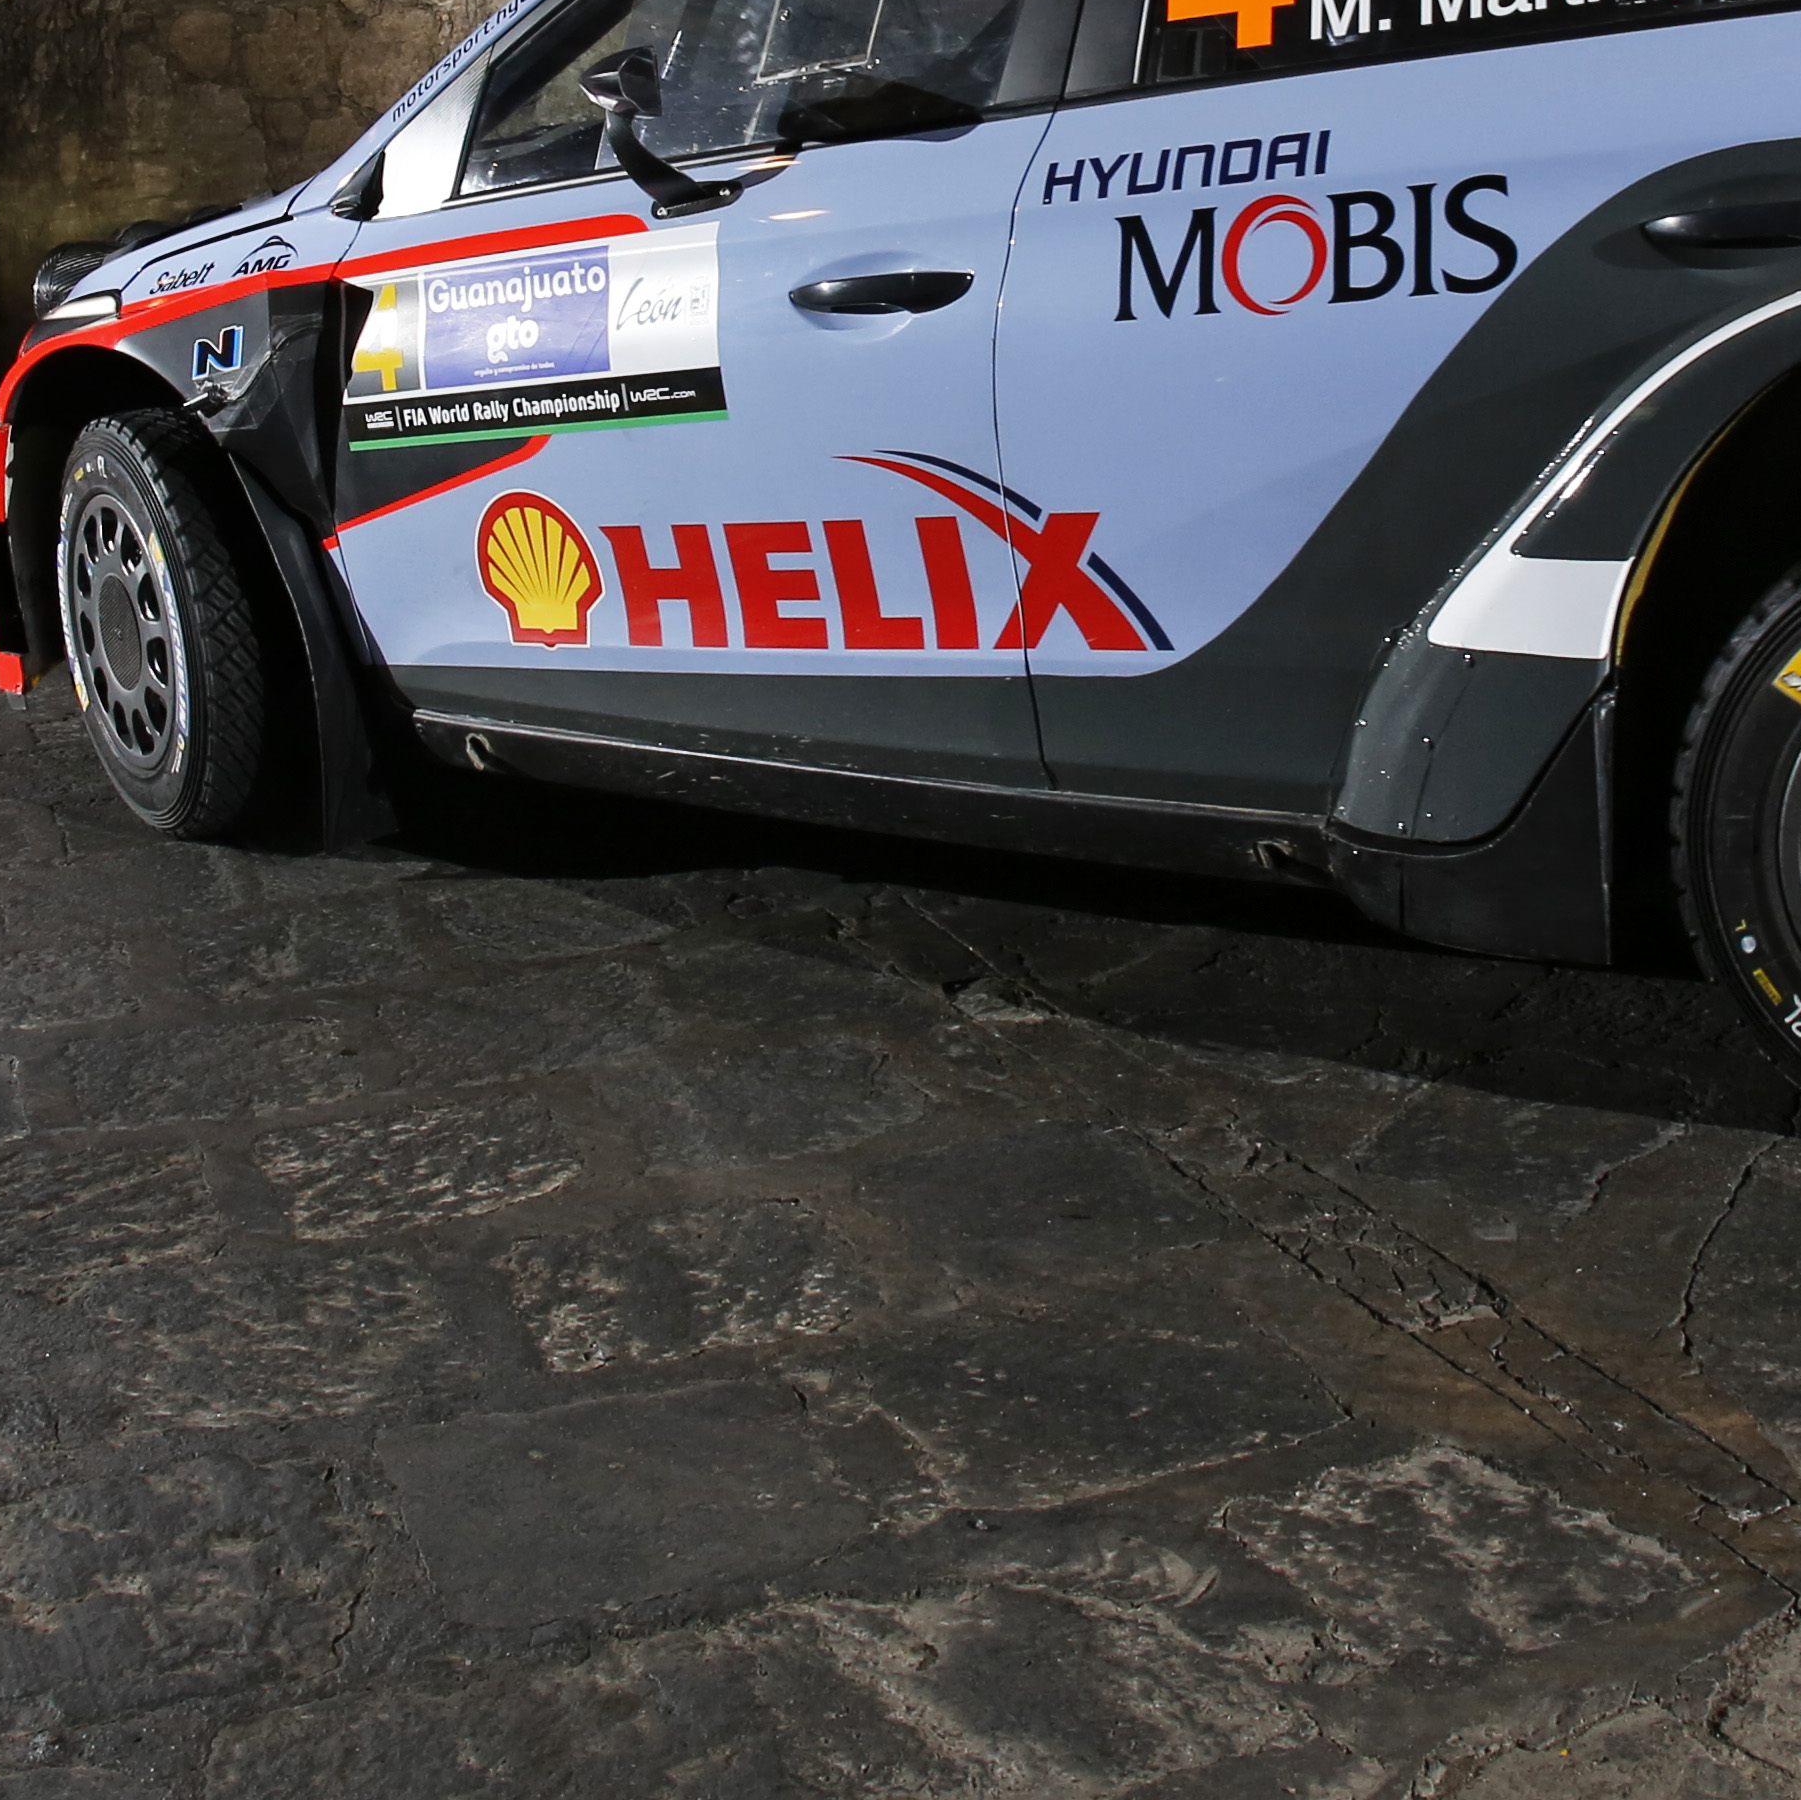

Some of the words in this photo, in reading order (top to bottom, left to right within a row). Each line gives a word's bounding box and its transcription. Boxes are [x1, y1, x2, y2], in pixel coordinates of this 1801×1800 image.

[1042, 129, 1332, 206] HYUNDAI
[231, 252, 293, 279] AMG
[1114, 173, 1519, 323] MOBIS
[149, 260, 216, 296] Sabelt
[426, 260, 607, 314] Guanajuato
[615, 276, 684, 332] León
[352, 283, 405, 392] 4
[486, 315, 540, 365] gto
[403, 407, 428, 428] FIA
[427, 403, 470, 425] World
[473, 400, 509, 423] Rally
[513, 389, 621, 418] Championship
[598, 505, 1149, 651] HELIX
